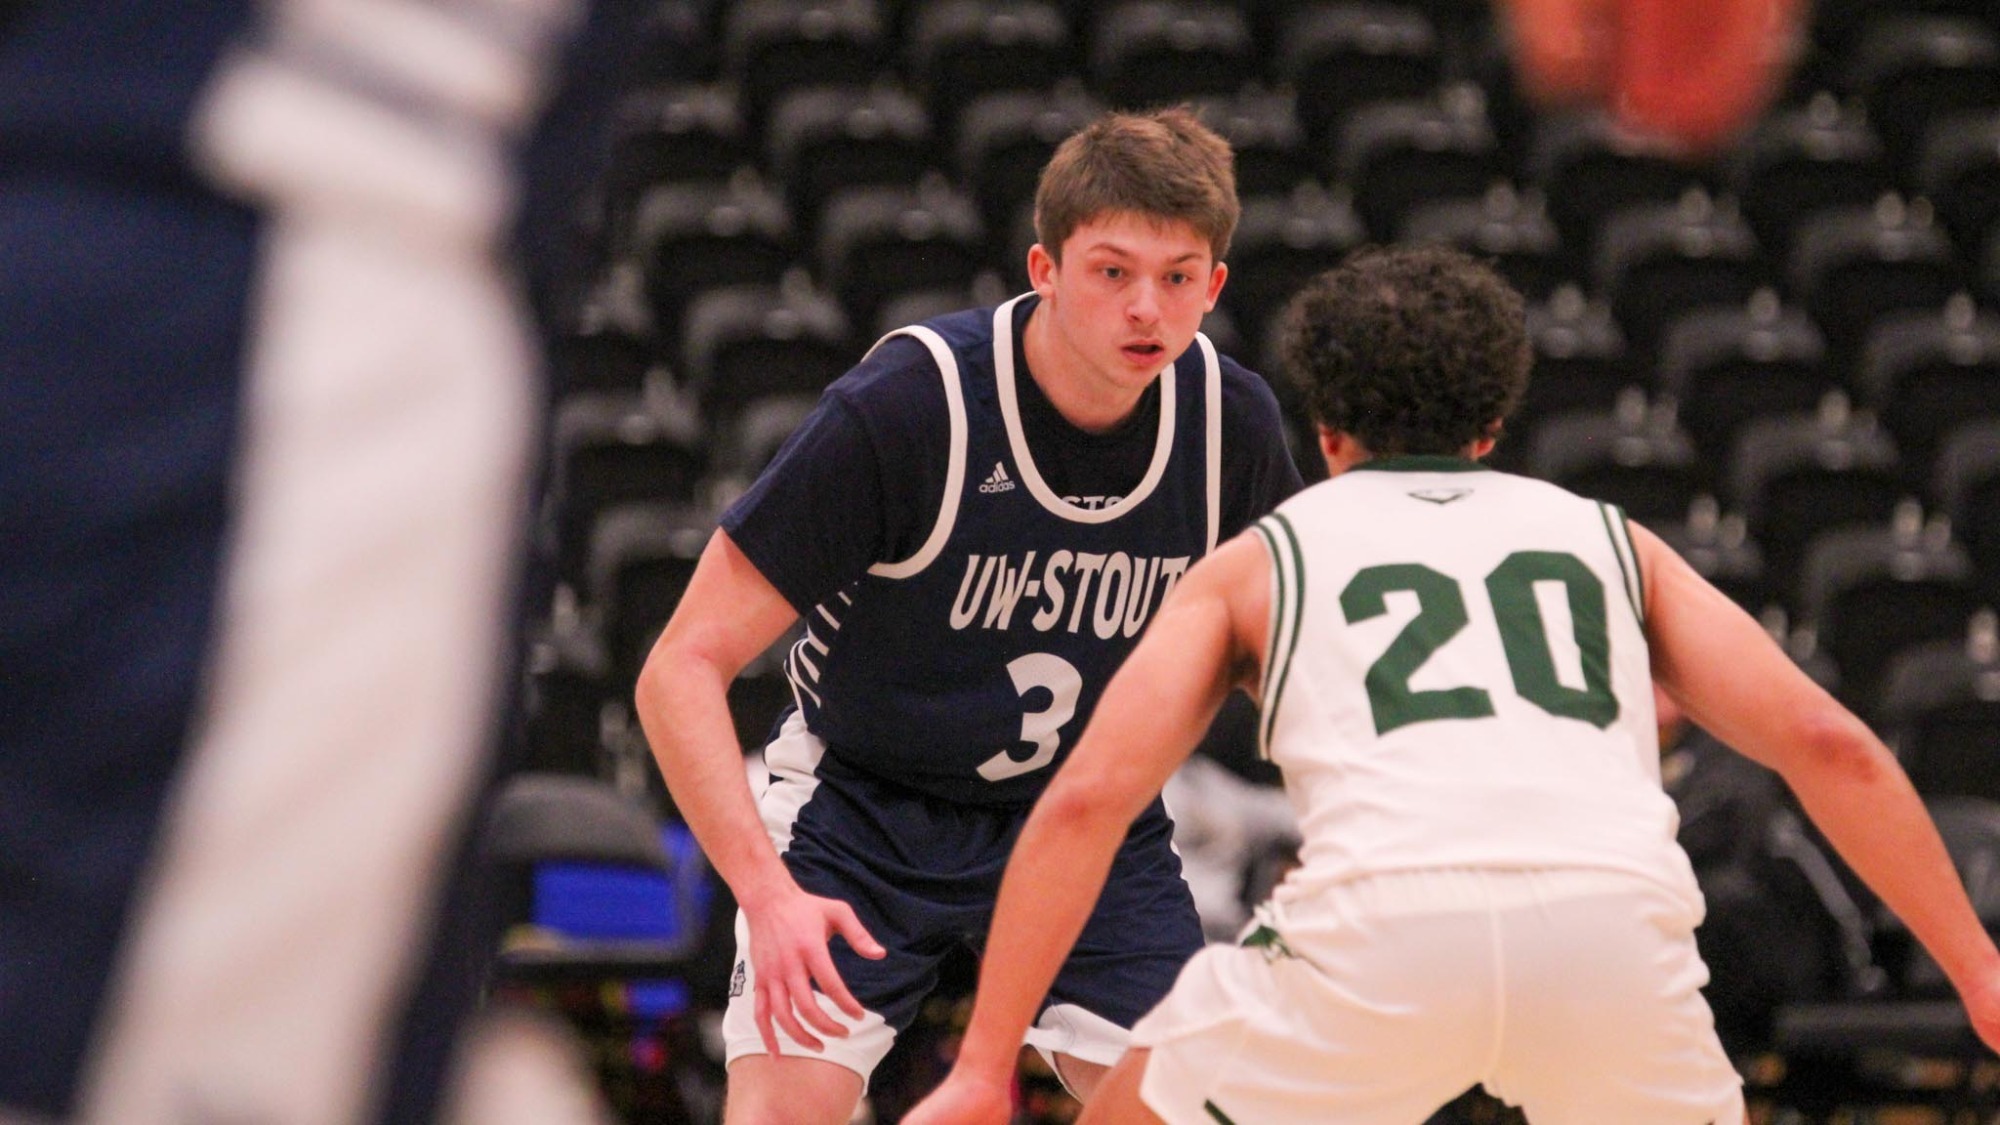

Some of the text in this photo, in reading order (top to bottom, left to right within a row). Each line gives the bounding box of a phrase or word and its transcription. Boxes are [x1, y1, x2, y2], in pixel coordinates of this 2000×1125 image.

[979, 480, 1016, 493] adidas
[949, 549, 1191, 640] UW-STOUT
[1339, 550, 1620, 737] 20
[976, 652, 1083, 782] 3
